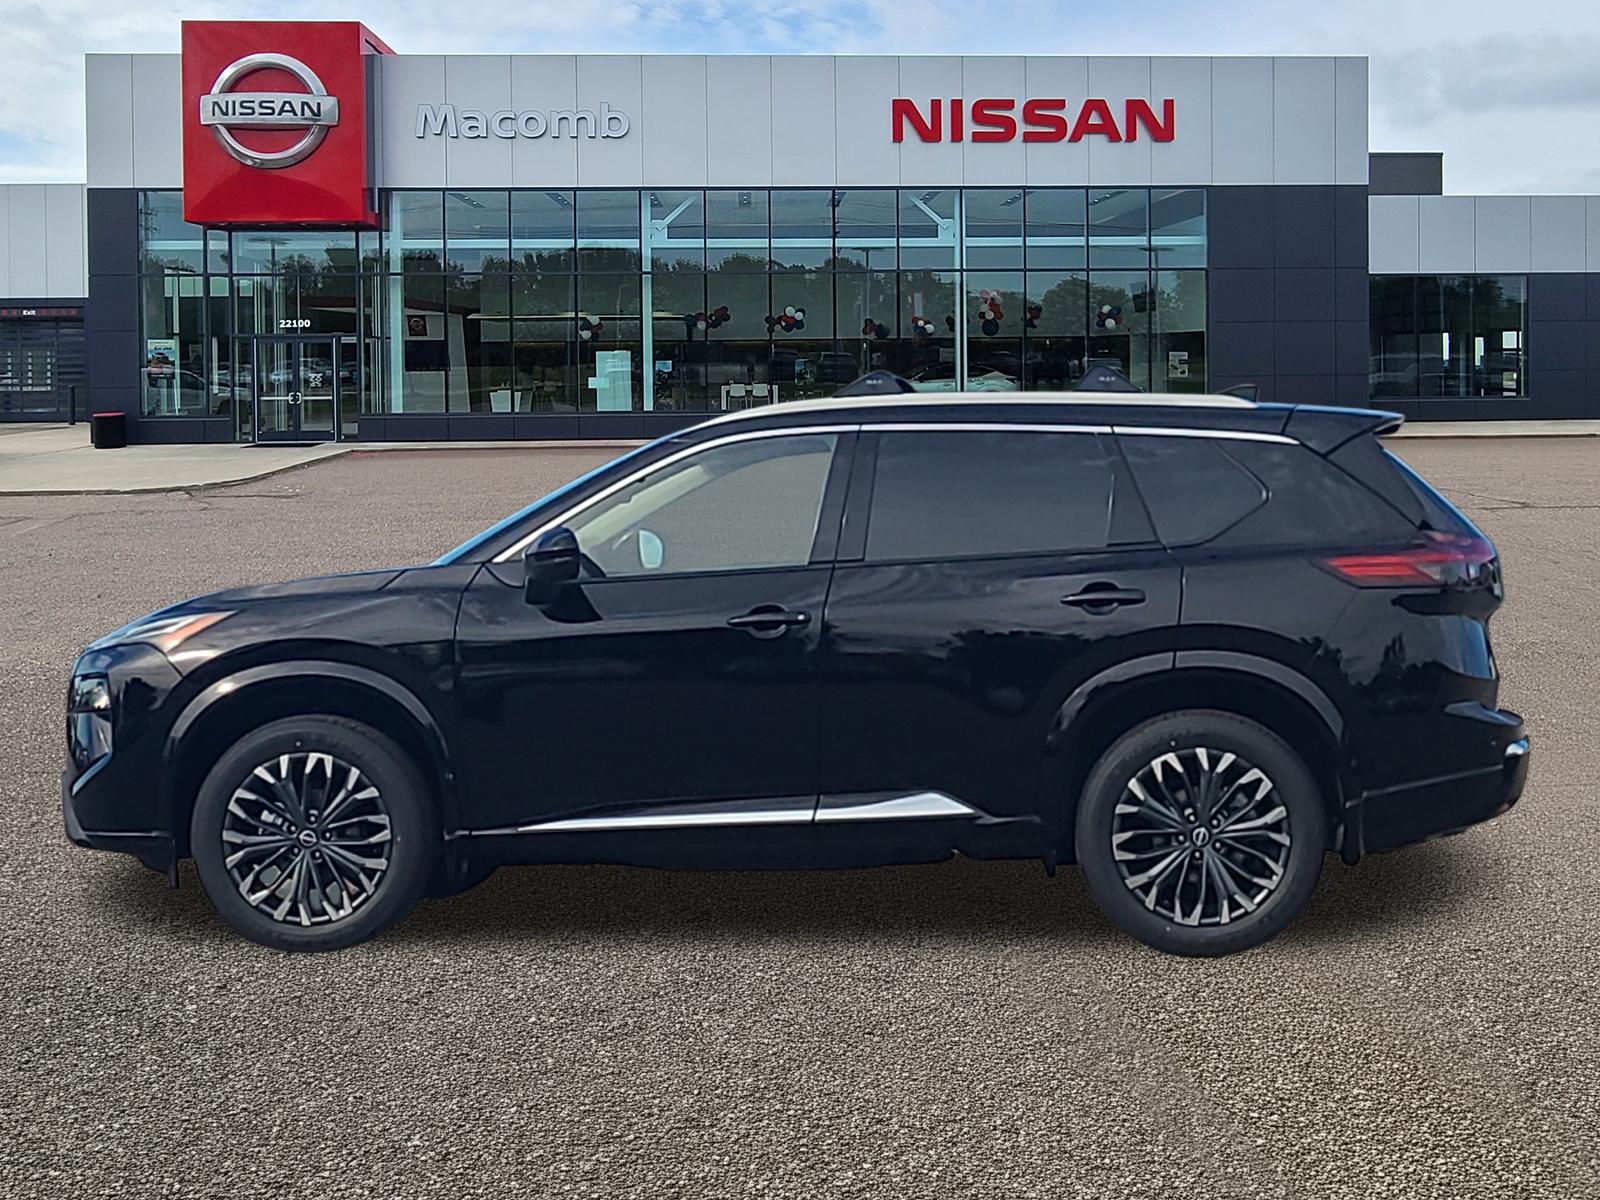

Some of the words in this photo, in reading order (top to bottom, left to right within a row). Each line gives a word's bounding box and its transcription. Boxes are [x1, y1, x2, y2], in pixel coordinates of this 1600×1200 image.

[211, 100, 322, 118] NISSAN
[415, 101, 630, 139] Macomb
[892, 98, 1175, 143] NISSAN
[279, 319, 311, 328] 22100
